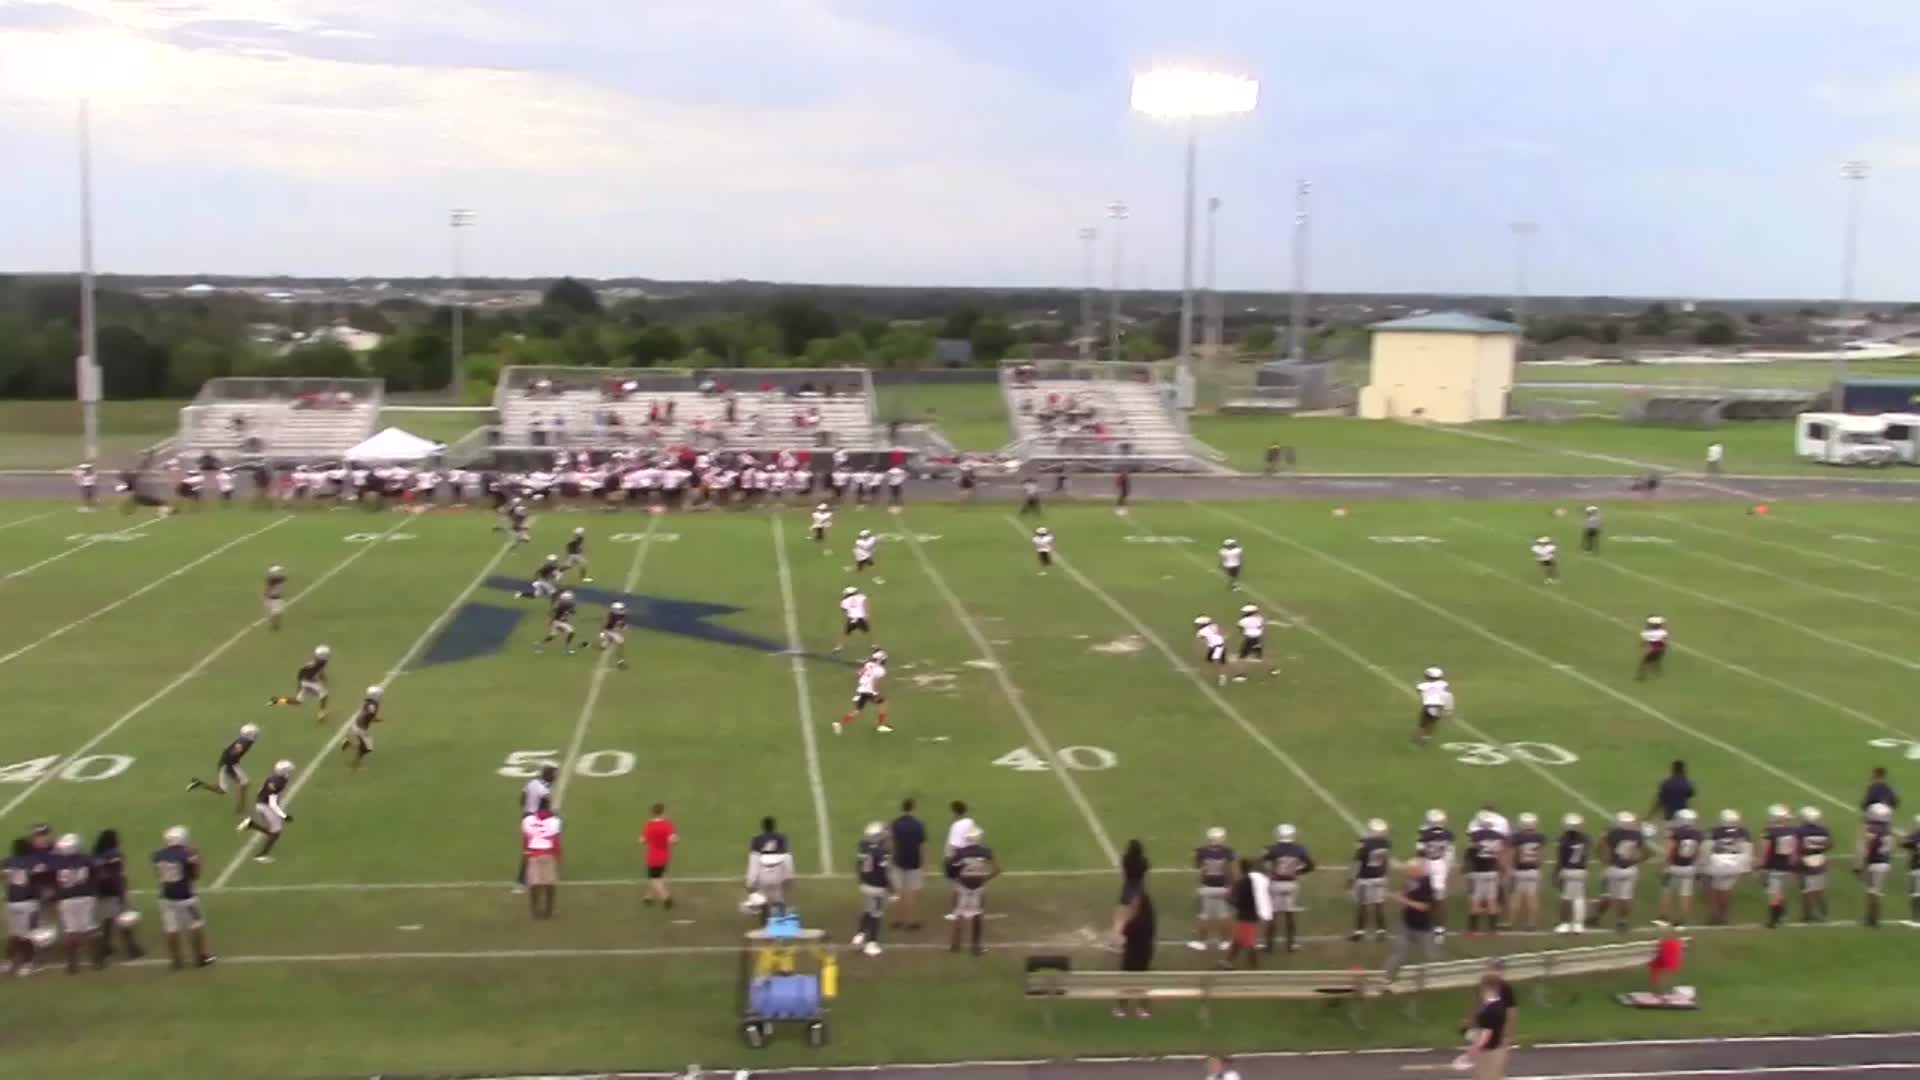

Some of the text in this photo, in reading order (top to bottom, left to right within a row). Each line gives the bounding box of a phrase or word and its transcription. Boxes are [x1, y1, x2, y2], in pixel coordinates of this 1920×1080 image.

[497, 750, 637, 776] 50
[991, 746, 1118, 771] 40
[1440, 742, 1580, 765] 30
[0, 754, 135, 782] 40
